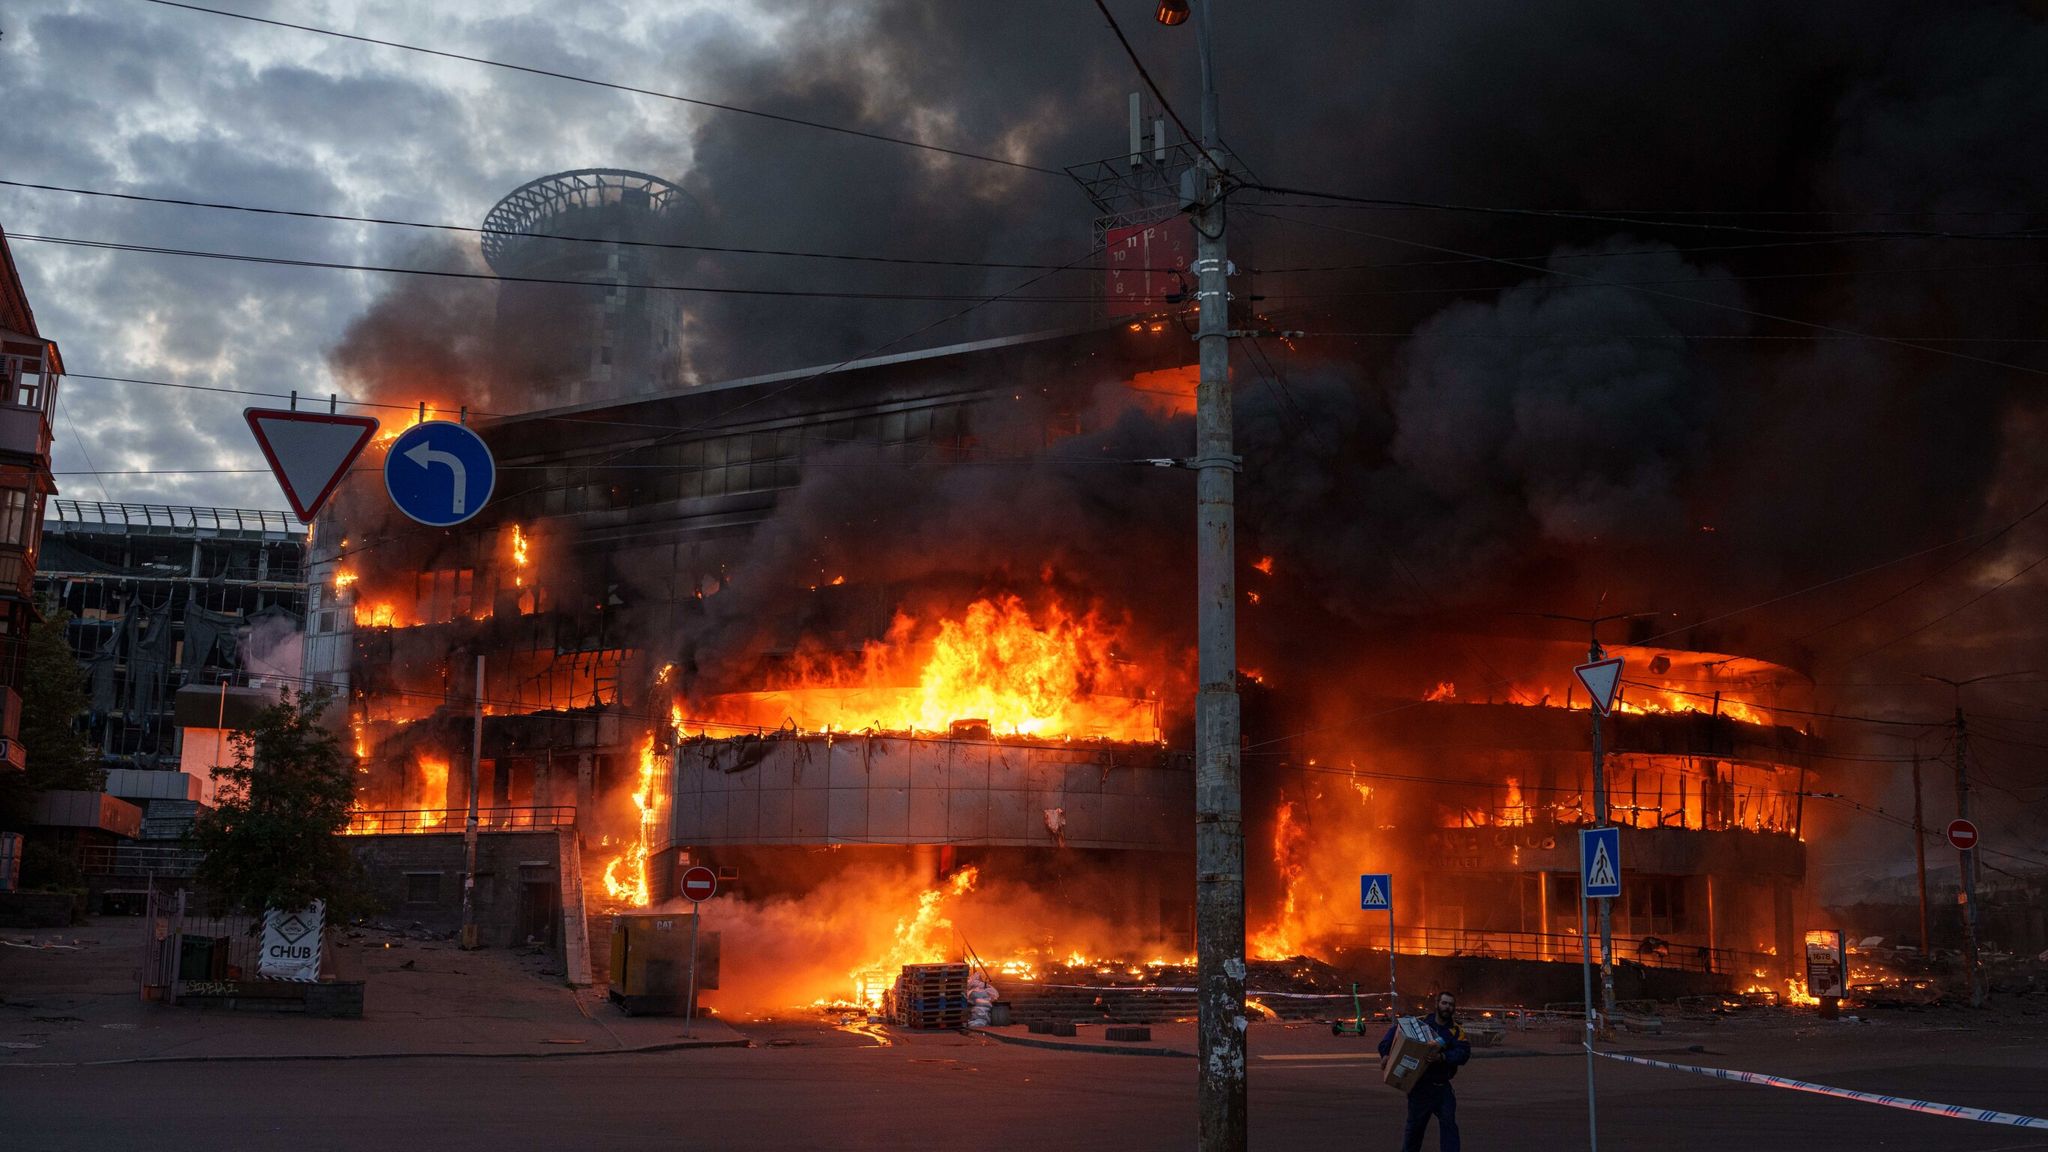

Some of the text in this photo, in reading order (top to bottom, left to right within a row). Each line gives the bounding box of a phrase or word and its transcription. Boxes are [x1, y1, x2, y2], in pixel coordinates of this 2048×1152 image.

[1143, 228, 1155, 239] 12
[1162, 231, 1168, 241] 1
[1127, 237, 1137, 248] 11
[1174, 241, 1180, 252] 2
[1114, 251, 1126, 261] 10
[1177, 256, 1184, 267] 3
[1113, 268, 1121, 278] 9
[1116, 283, 1124, 294] 8
[1160, 287, 1167, 296] 5
[1128, 292, 1136, 301] 7
[656, 920, 673, 929] CAT
[269, 945, 311, 959] CHUB
